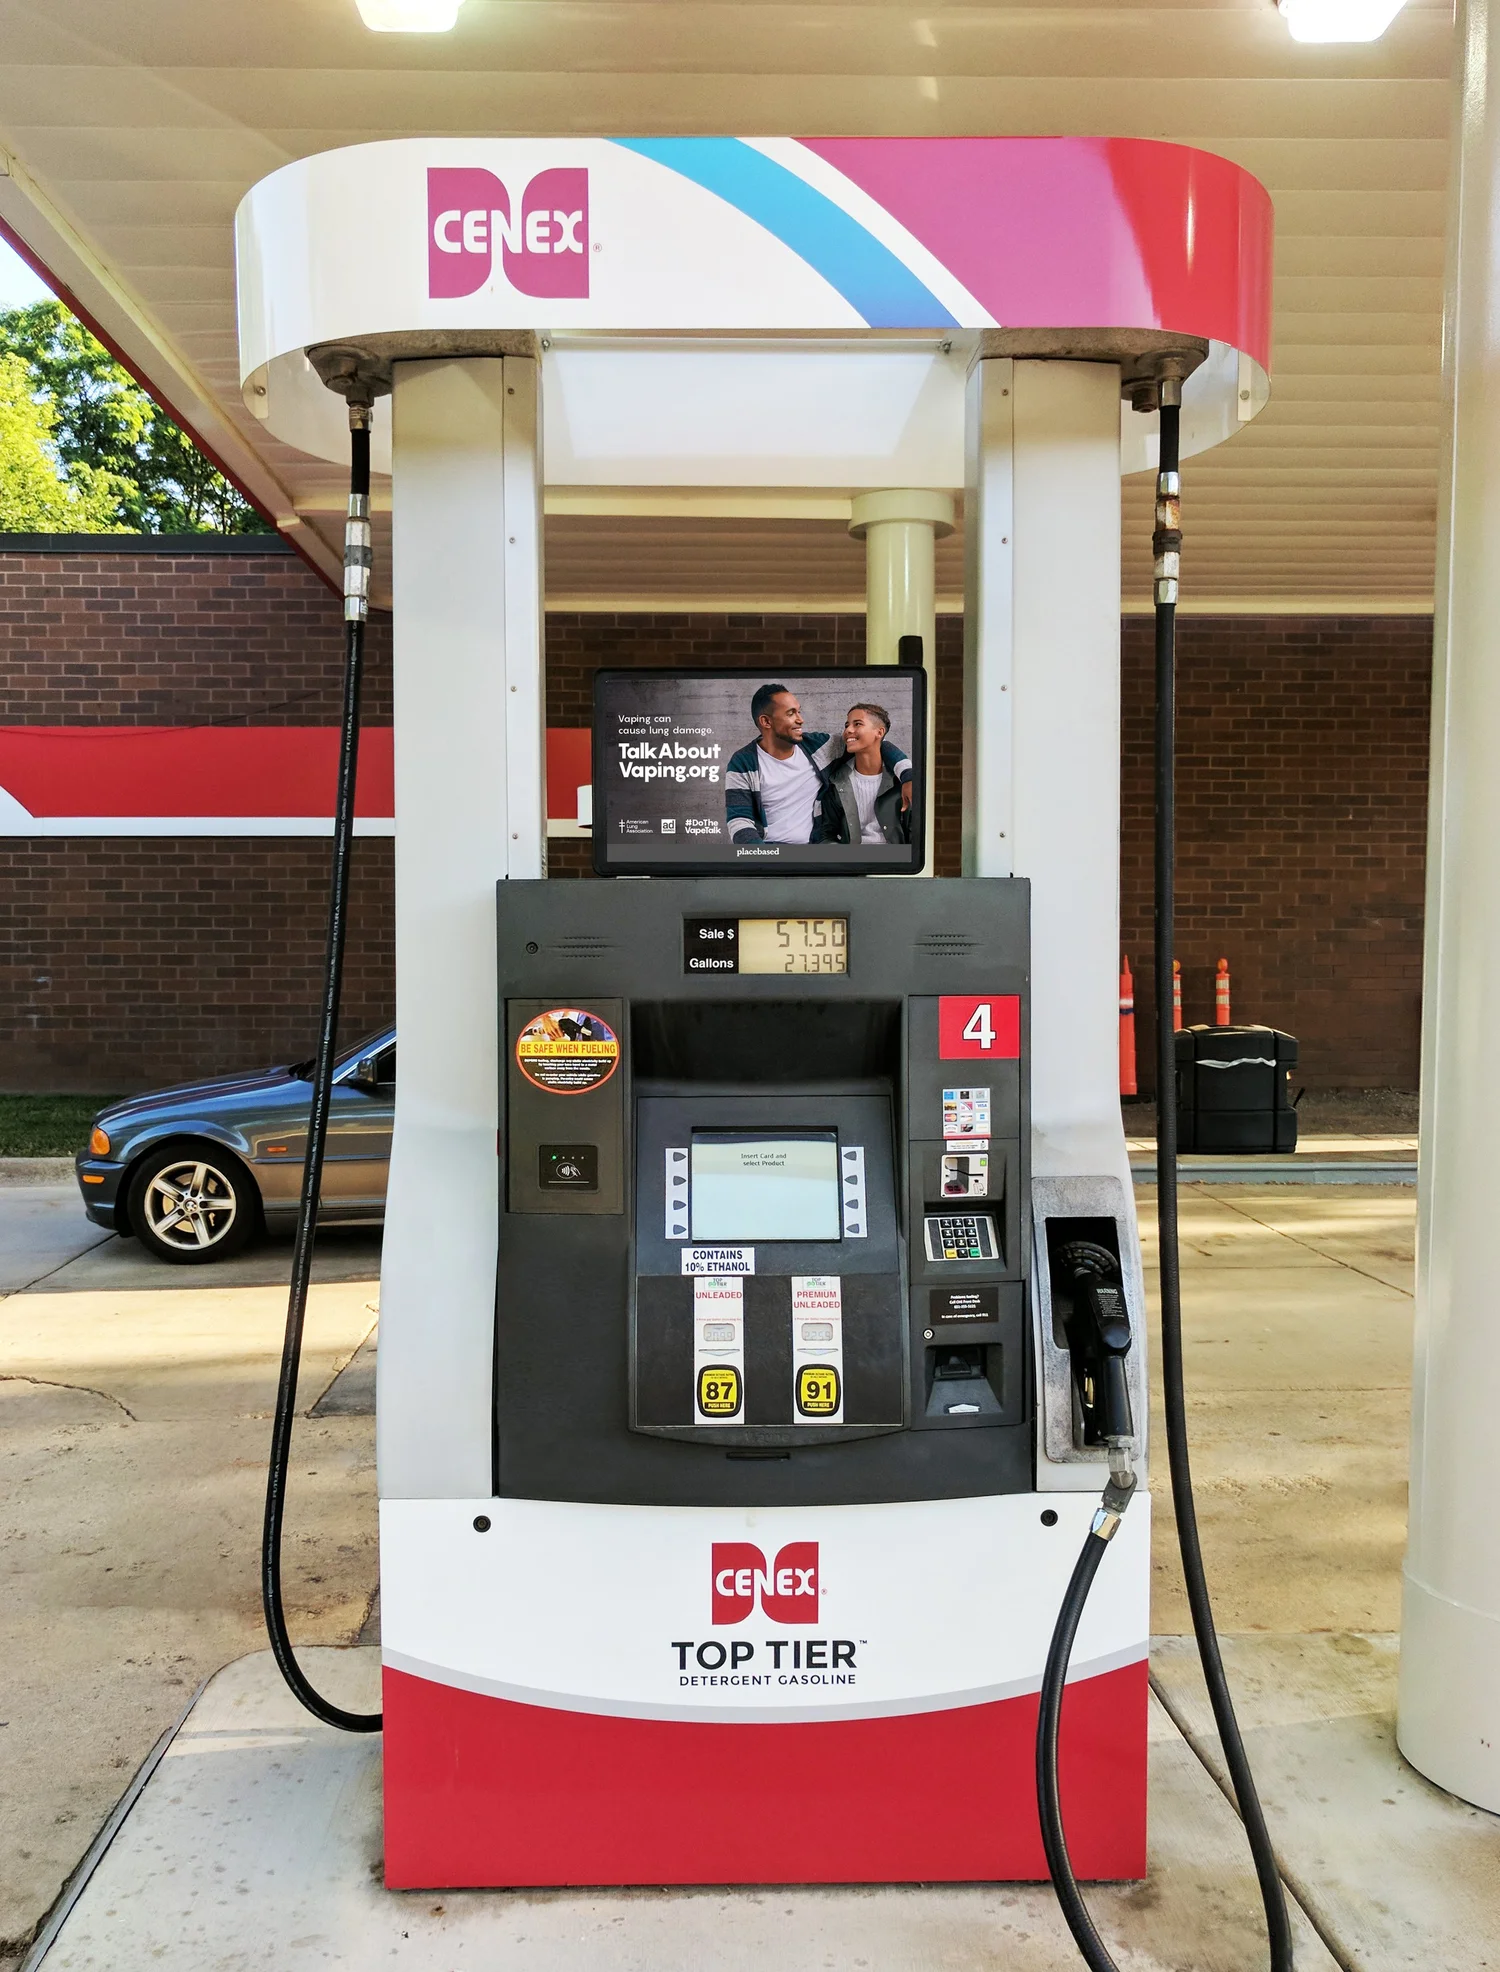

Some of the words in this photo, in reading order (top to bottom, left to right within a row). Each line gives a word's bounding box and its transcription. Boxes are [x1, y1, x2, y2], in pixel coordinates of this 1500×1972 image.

[433, 209, 584, 254] CENEX
[618, 714, 651, 725] Vaping
[649, 726, 669, 736] lung
[673, 726, 714, 736] damage.
[619, 761, 720, 782] Vaping.org
[685, 826, 721, 835] VapeTalk
[736, 847, 780, 857] placebased
[699, 929, 724, 939] Sale
[727, 928, 735, 940] $
[777, 920, 845, 948] 57.50
[689, 958, 734, 968] Gallons
[785, 954, 845, 972] 27.395
[962, 1003, 997, 1050] 4
[521, 1044, 531, 1053] BE
[533, 1044, 554, 1053] SAFE
[555, 1044, 579, 1053] WHEN
[581, 1044, 616, 1053] FUELING
[693, 1250, 743, 1260] CONTAINS
[685, 1262, 705, 1272] 10%
[707, 1261, 751, 1272] ETHANOL
[793, 1301, 841, 1309] UNLEADED
[705, 1381, 734, 1400] 87
[806, 1380, 832, 1400] 91
[715, 1568, 815, 1597] CENEX
[671, 1640, 755, 1670] TOP
[679, 1675, 772, 1686] DETERGENT
[778, 1674, 856, 1685] GASOLINE
